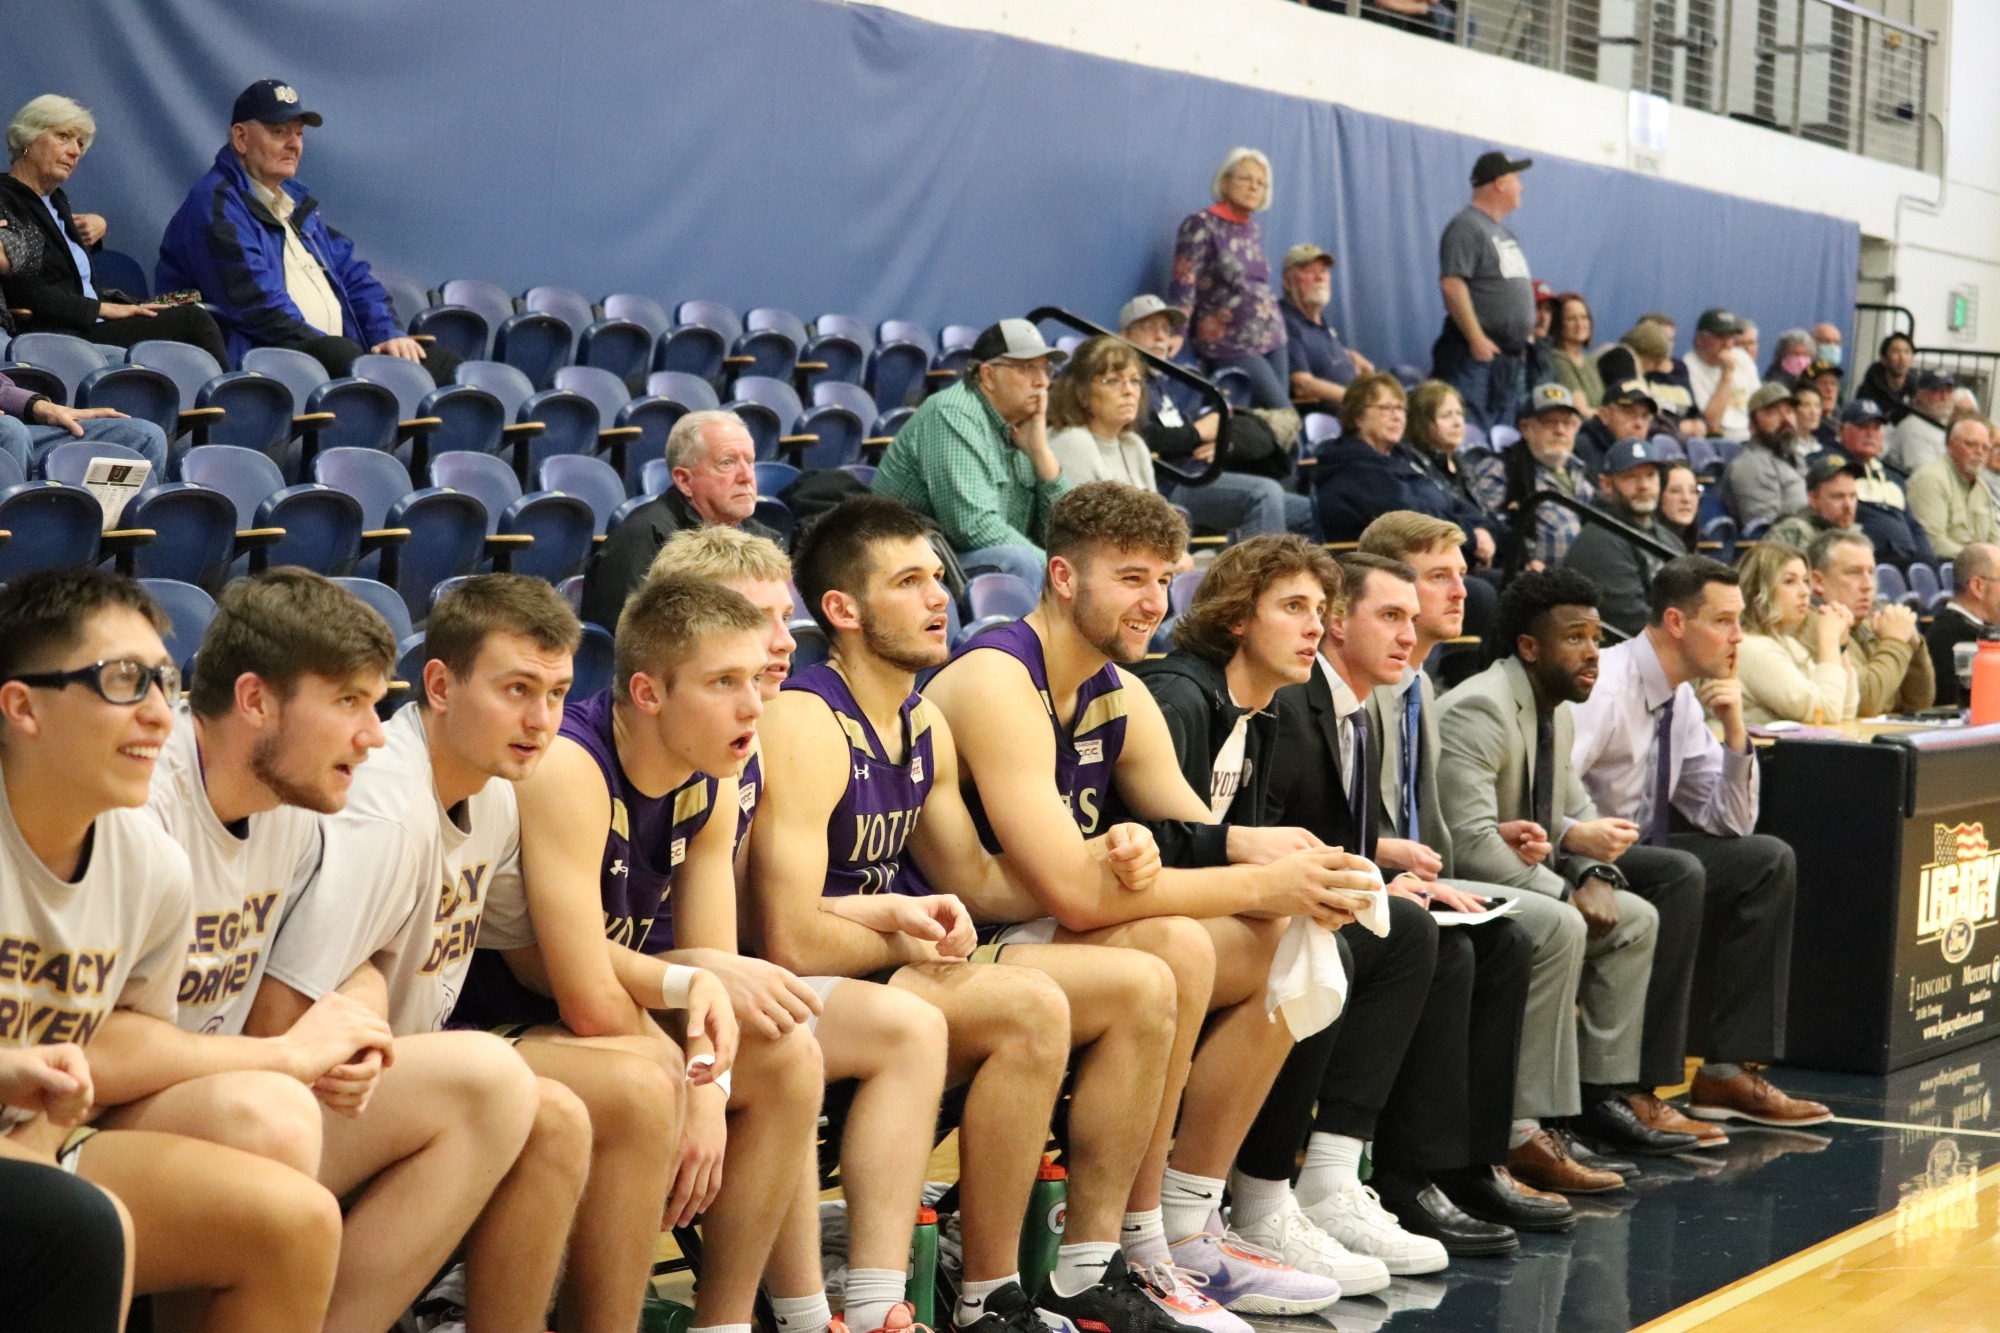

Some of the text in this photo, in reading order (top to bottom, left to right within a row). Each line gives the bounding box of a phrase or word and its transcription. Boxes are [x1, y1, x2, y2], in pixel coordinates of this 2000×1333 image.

[1917, 854, 2000, 936] LEGACY
[1916, 974, 1953, 1001] LINCOLN
[1962, 963, 1992, 986] Mercury
